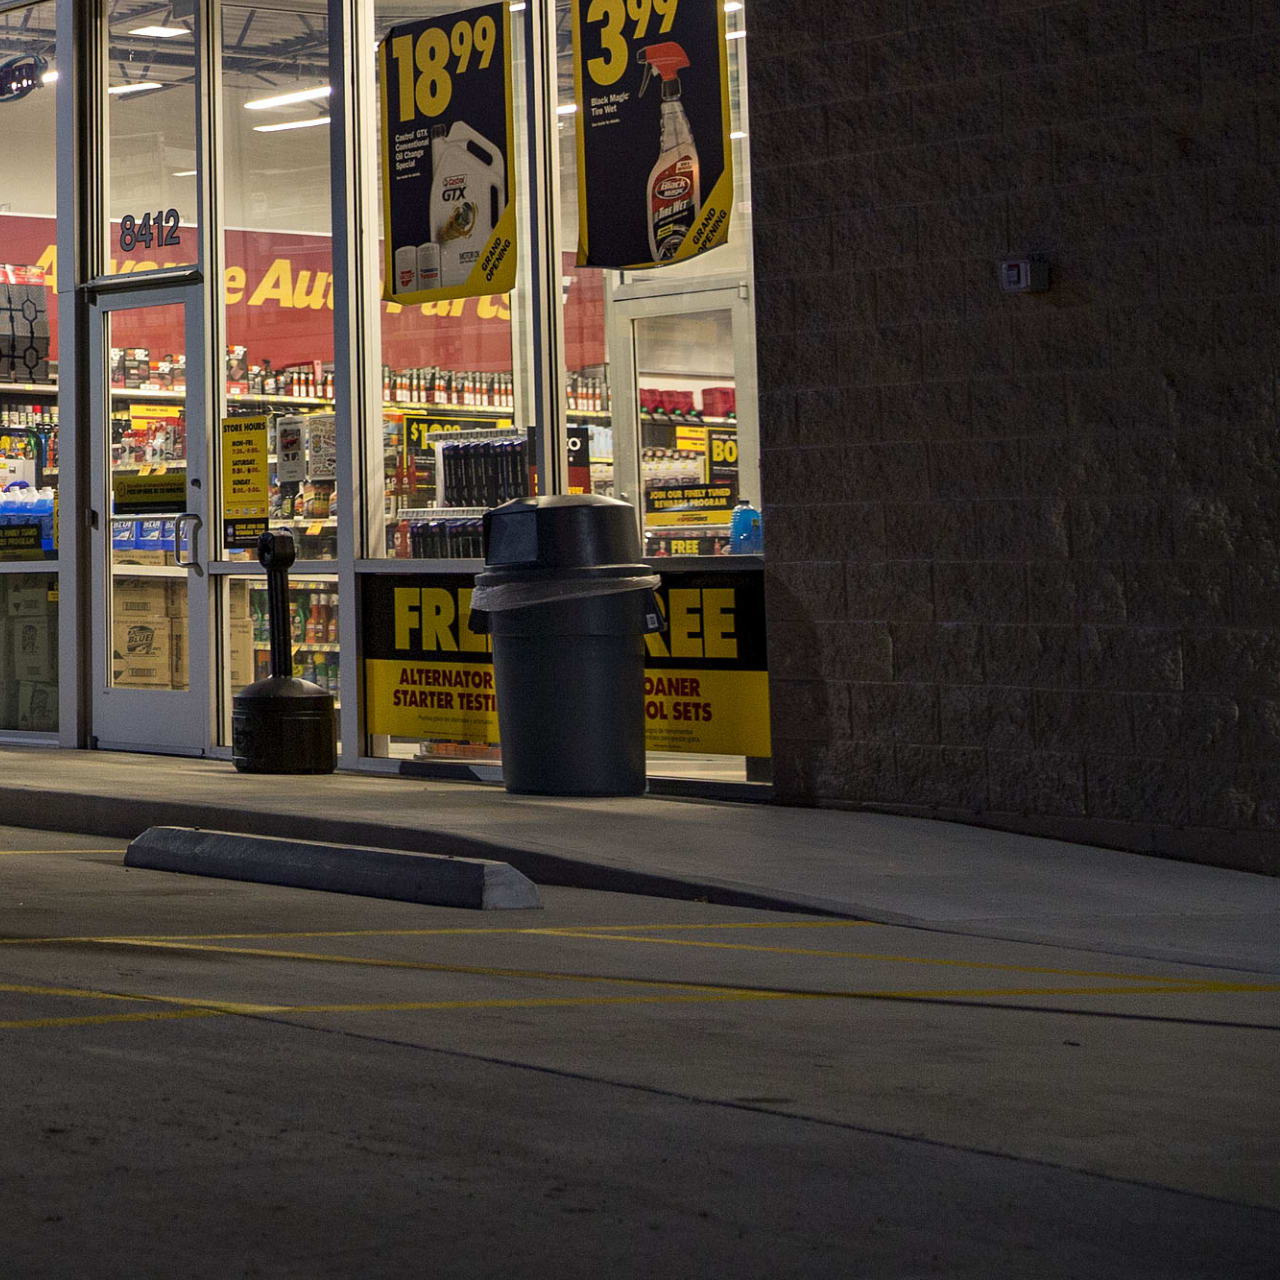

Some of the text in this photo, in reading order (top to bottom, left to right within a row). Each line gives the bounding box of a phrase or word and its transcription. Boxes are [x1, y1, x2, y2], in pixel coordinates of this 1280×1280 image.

[591, 91, 630, 107] Black Magic
[591, 104, 617, 117] Tire Wet
[416, 128, 429, 138] GTX
[404, 149, 425, 160] Change
[395, 159, 416, 171] Special
[442, 186, 467, 202] GTX
[120, 208, 180, 252] 8412
[692, 208, 716, 245] GRAND
[481, 237, 503, 272] GRAND
[486, 239, 512, 282] OPENING
[224, 421, 266, 433] STORE HOURS
[650, 491, 666, 499] JOIN
[667, 490, 682, 499] OUR
[689, 497, 727, 507] PROGRAM
[671, 540, 699, 554] FREE
[399, 668, 493, 690] ALTERNATOR
[645, 677, 701, 697] OANER
[393, 689, 496, 712] STARTER TESTI
[646, 701, 713, 722] OL SETS
